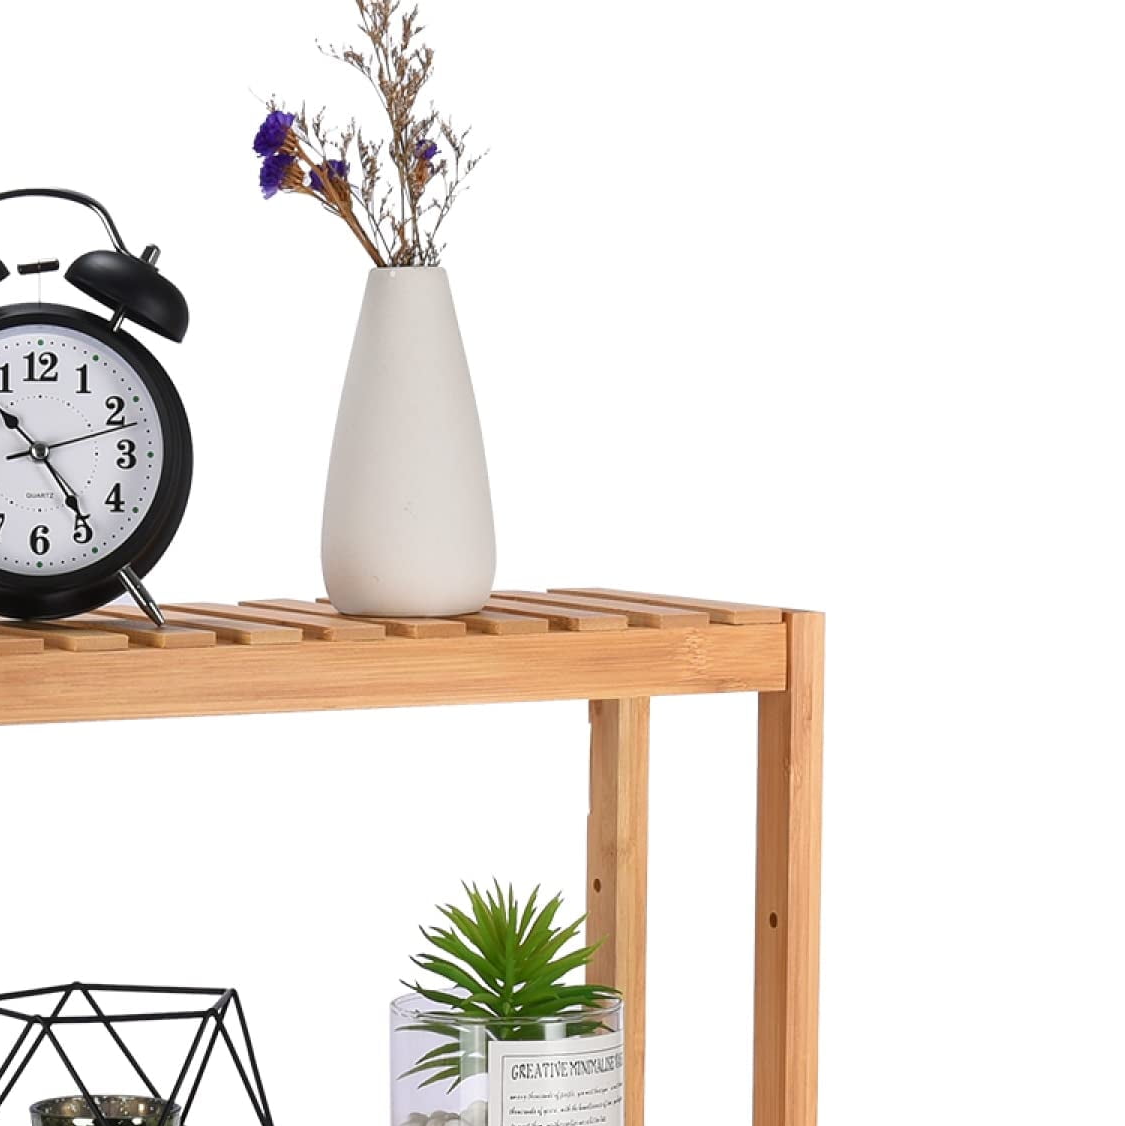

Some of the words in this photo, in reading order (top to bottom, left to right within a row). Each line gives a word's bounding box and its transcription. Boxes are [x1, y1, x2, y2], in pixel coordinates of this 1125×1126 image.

[23, 351, 58, 382] 12
[75, 363, 92, 393] 1
[105, 396, 125, 426] 2
[116, 439, 137, 469] 3
[104, 483, 125, 512] 4
[30, 525, 50, 555] 6
[73, 514, 93, 544] 5
